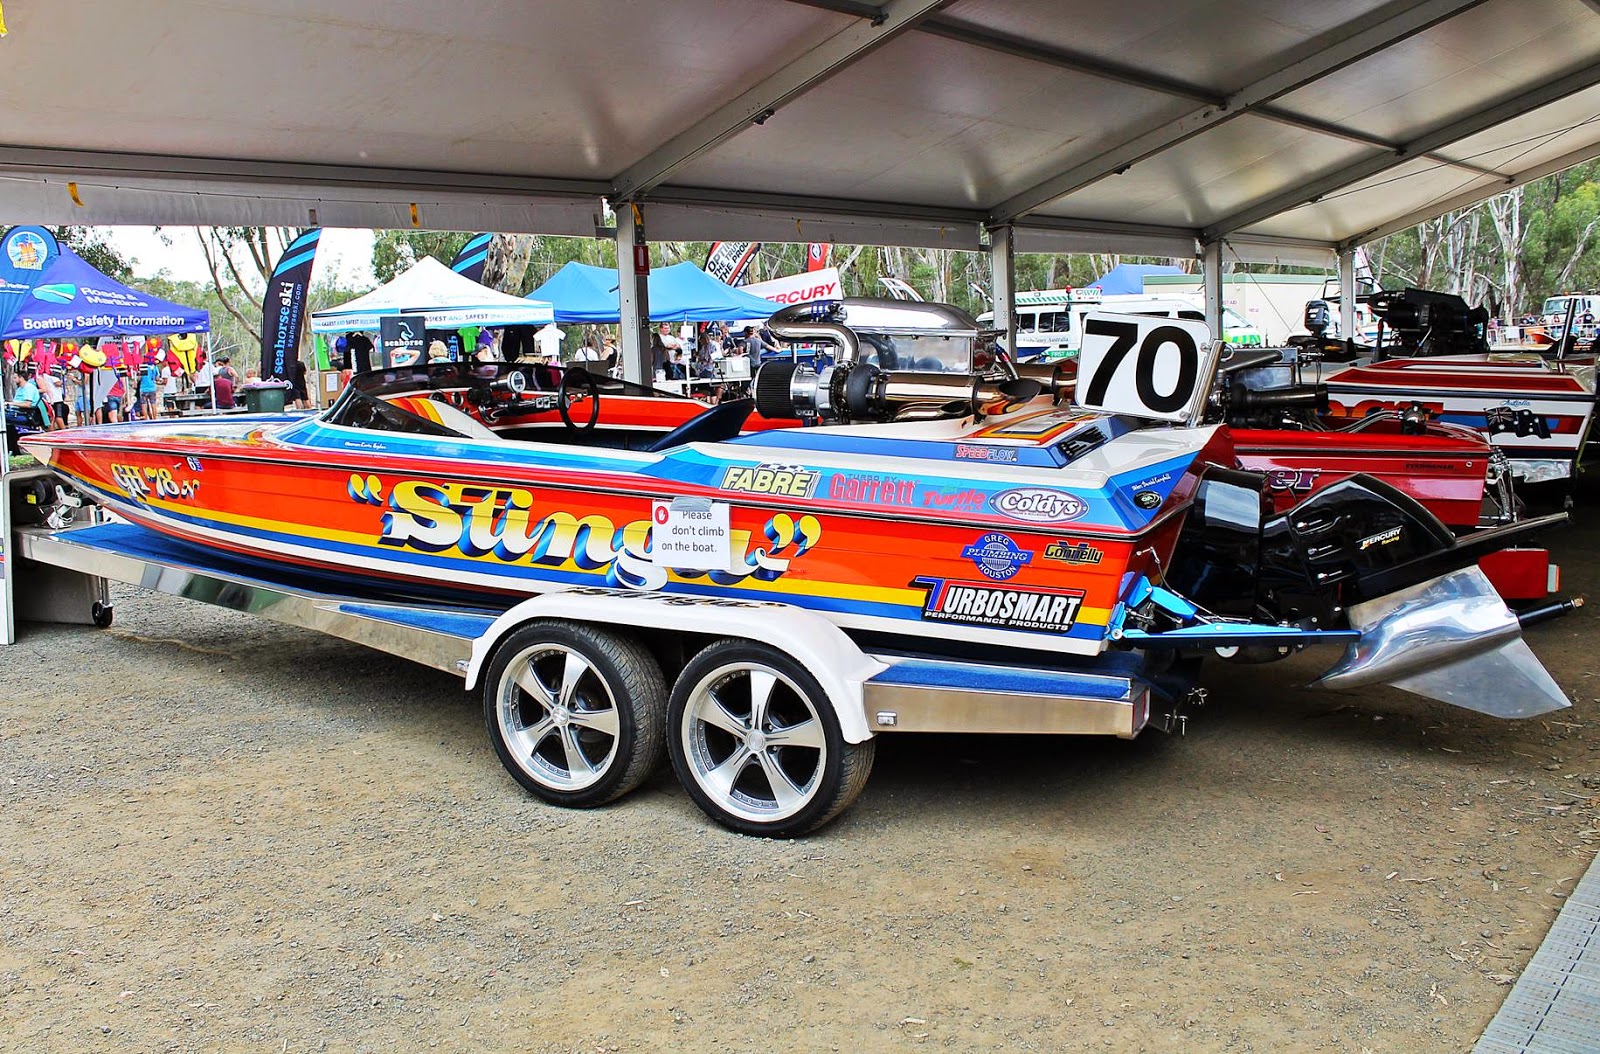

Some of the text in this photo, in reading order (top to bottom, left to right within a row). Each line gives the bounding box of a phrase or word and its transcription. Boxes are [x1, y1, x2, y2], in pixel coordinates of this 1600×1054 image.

[719, 262, 734, 283] THE
[80, 286, 126, 299] Roads
[766, 282, 837, 305] RCURY
[85, 296, 149, 307] Maritime
[23, 313, 185, 331] Boating Safety Information
[274, 282, 294, 375] seahorseski
[384, 339, 424, 347] seahorse
[1051, 350, 1064, 358] FIRST
[1084, 319, 1199, 413] 70
[956, 444, 1015, 461] SPEEDFLOW
[722, 467, 813, 497] FABRE
[829, 473, 917, 505] Garrett
[923, 489, 986, 506] Turtle
[1001, 493, 1079, 518] Coldys
[683, 511, 712, 520] Please
[672, 525, 725, 537] don't climb
[1360, 527, 1402, 550] MERCURY
[661, 541, 717, 553] on the boat.
[984, 535, 1009, 545] GREG
[966, 548, 1028, 561] PLUMBING
[1044, 544, 1104, 563] Connelly
[978, 562, 1017, 578] HOUSTON
[915, 577, 1084, 625] TURBOSMART
[924, 611, 1069, 631] PERFORMANCE PRODUCTS
